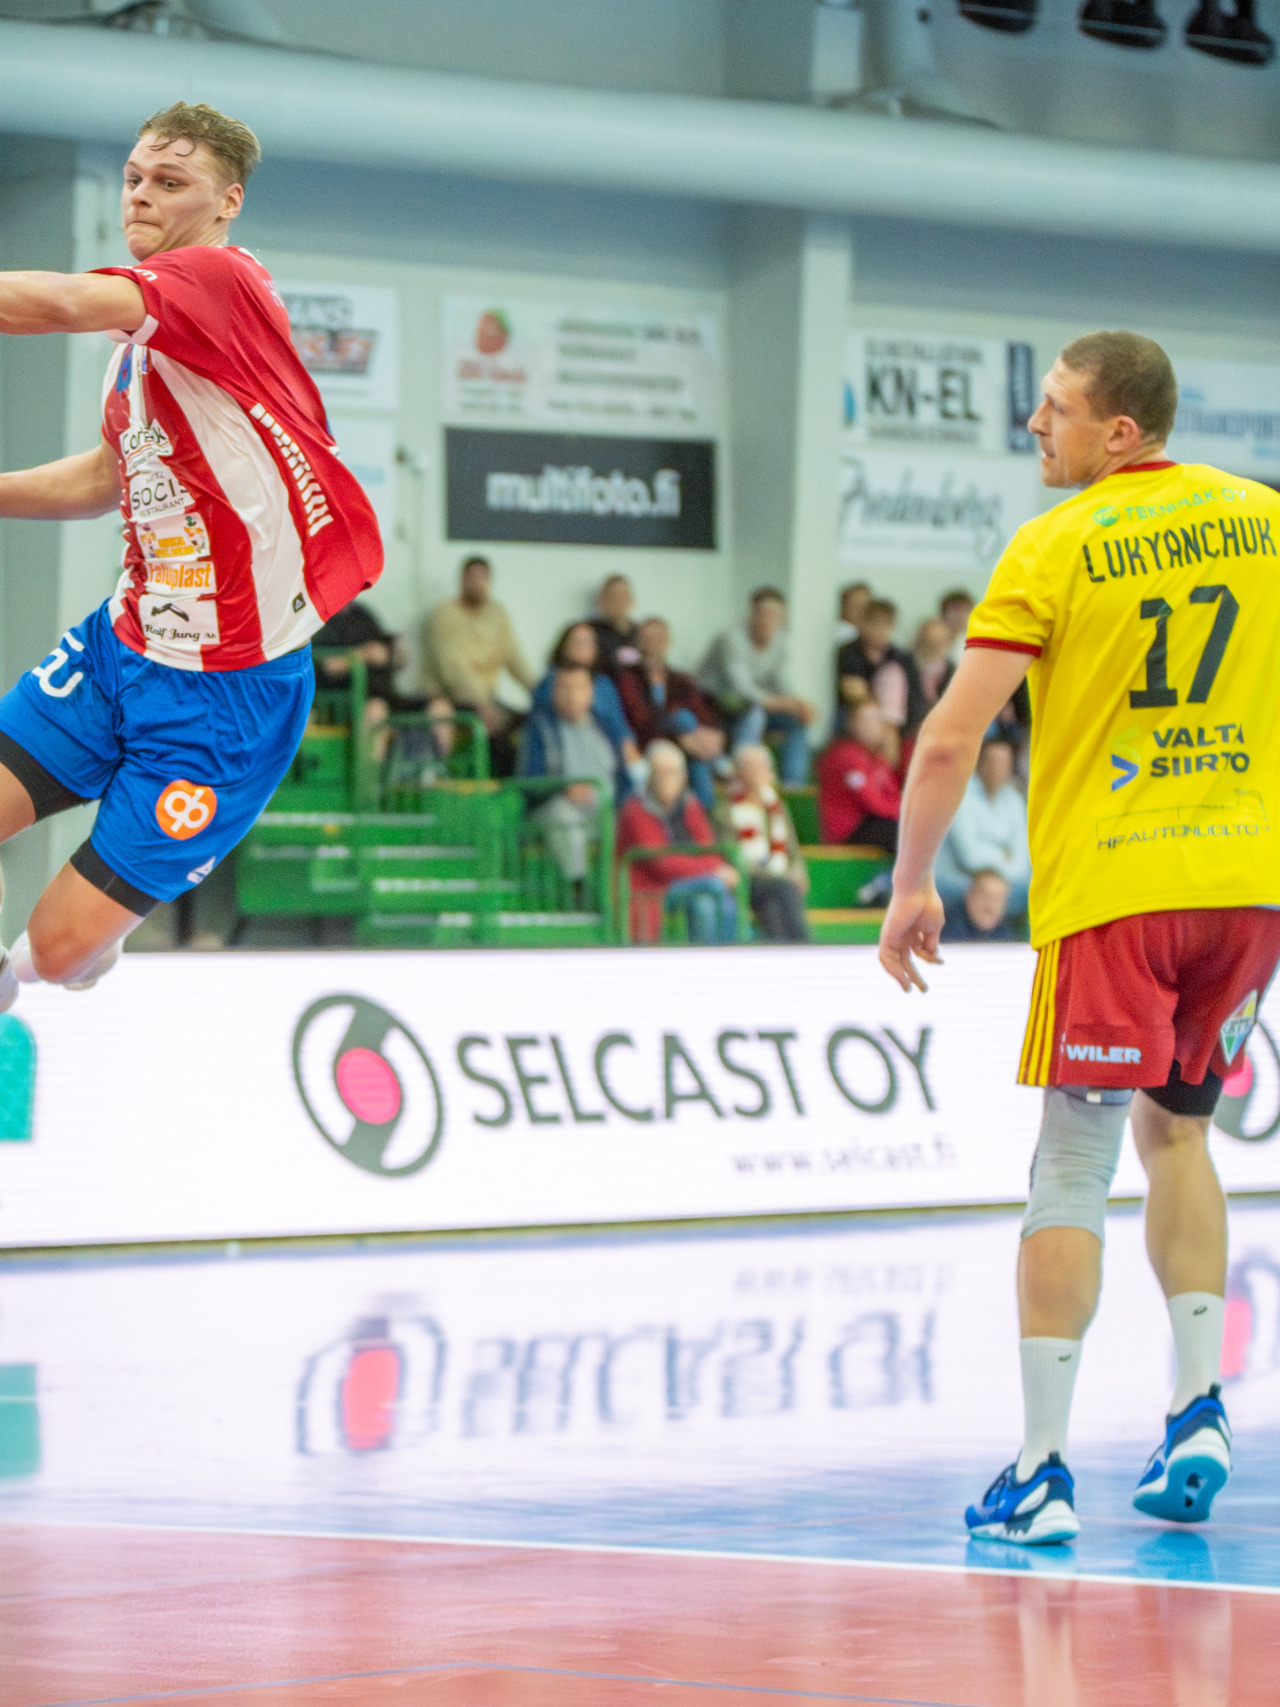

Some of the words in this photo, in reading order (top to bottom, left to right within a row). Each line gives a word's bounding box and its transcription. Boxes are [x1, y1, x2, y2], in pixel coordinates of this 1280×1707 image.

[486, 464, 682, 518] multifoto.fi
[1221, 487, 1247, 502] OY
[138, 497, 185, 517] ESTAURANT
[1082, 516, 1278, 584] LUKYANCHUK
[1128, 583, 1240, 709] 17
[1152, 723, 1245, 749] VALTA
[1149, 752, 1251, 778] SIIRTO
[1066, 1044, 1142, 1065] WILER
[457, 1028, 807, 1129] SELCAST
[825, 1024, 938, 1116] OY
